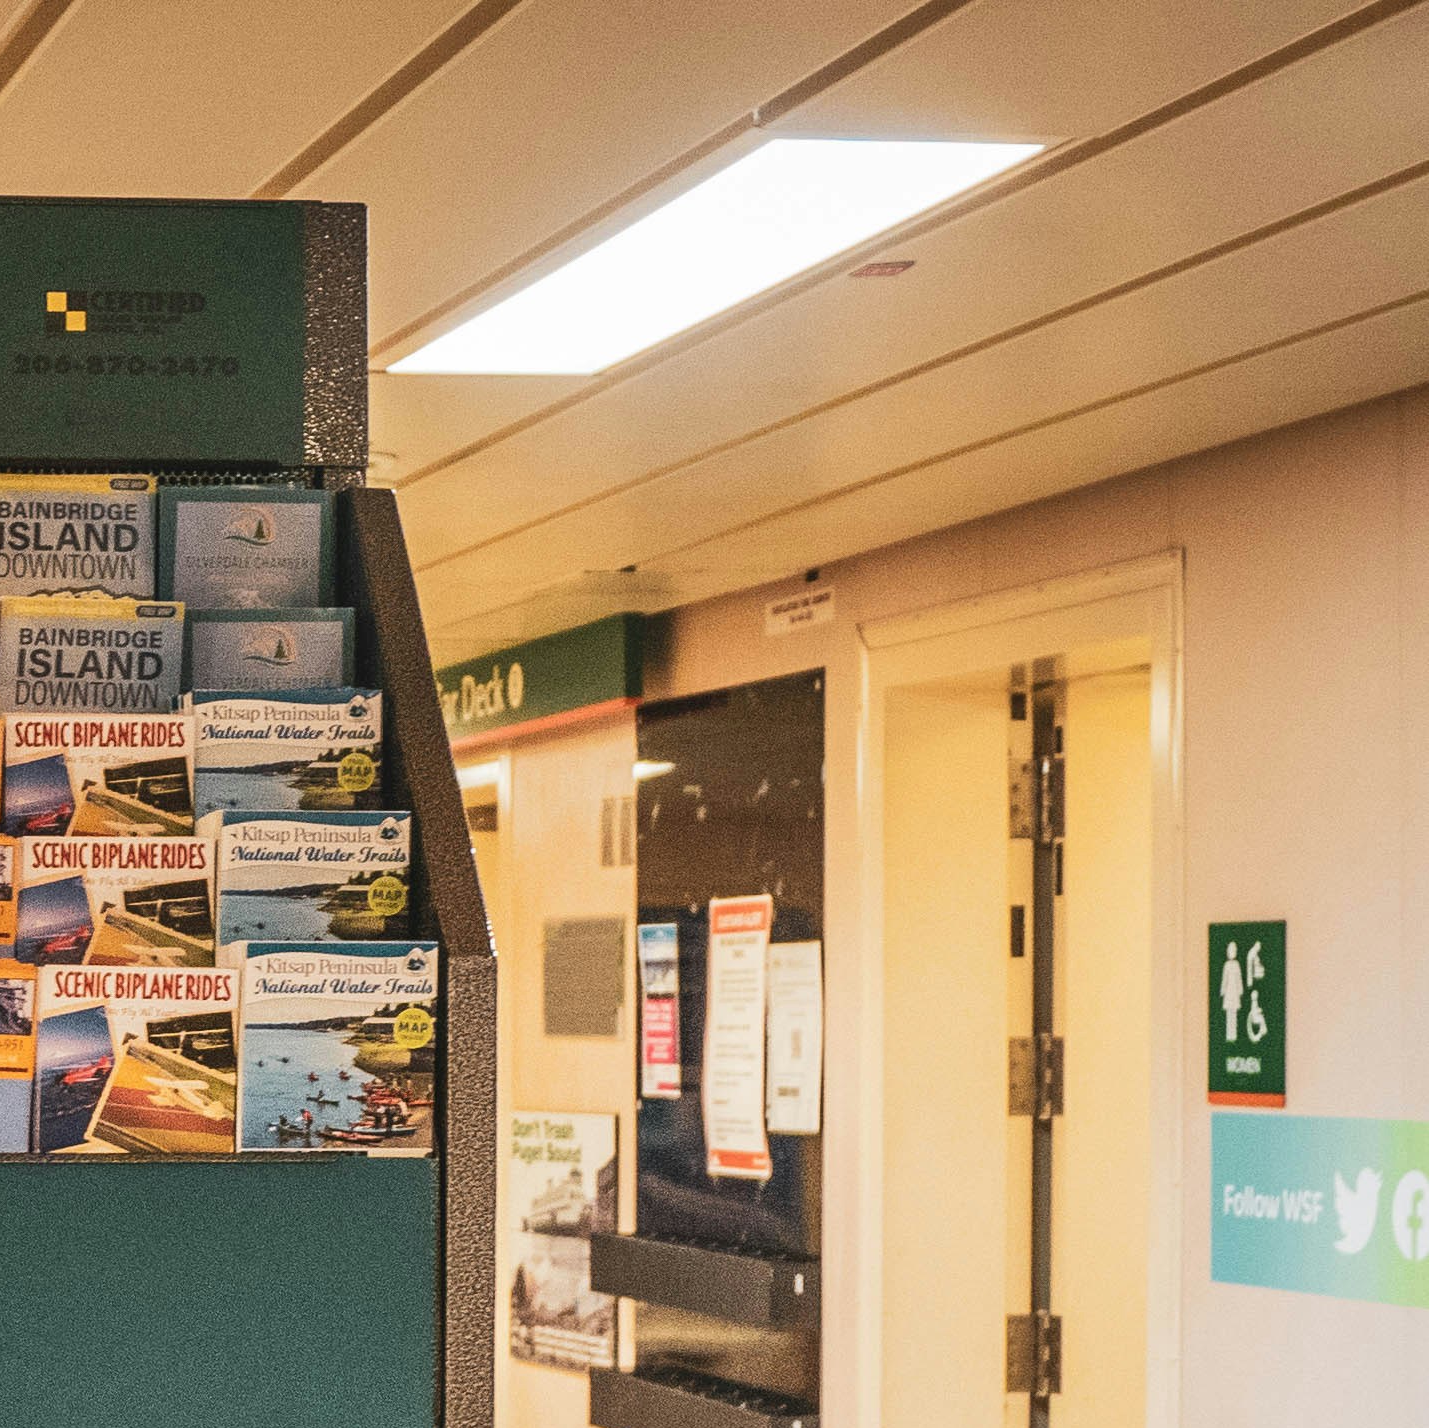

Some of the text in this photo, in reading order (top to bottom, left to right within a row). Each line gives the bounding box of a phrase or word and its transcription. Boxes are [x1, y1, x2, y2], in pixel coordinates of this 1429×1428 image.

[19, 628, 162, 649] BAINBRIDGE
[16, 650, 163, 680] ISLAND
[15, 681, 160, 708] DOWNTOWN
[266, 958, 397, 977] Kitsap Peninsula
[55, 971, 231, 1001] SCENIC BIPLANE RIDES
[255, 978, 433, 994] National Water Trails
[398, 1022, 428, 1032] MAP
[1223, 1185, 1323, 1224] Follow WSF
